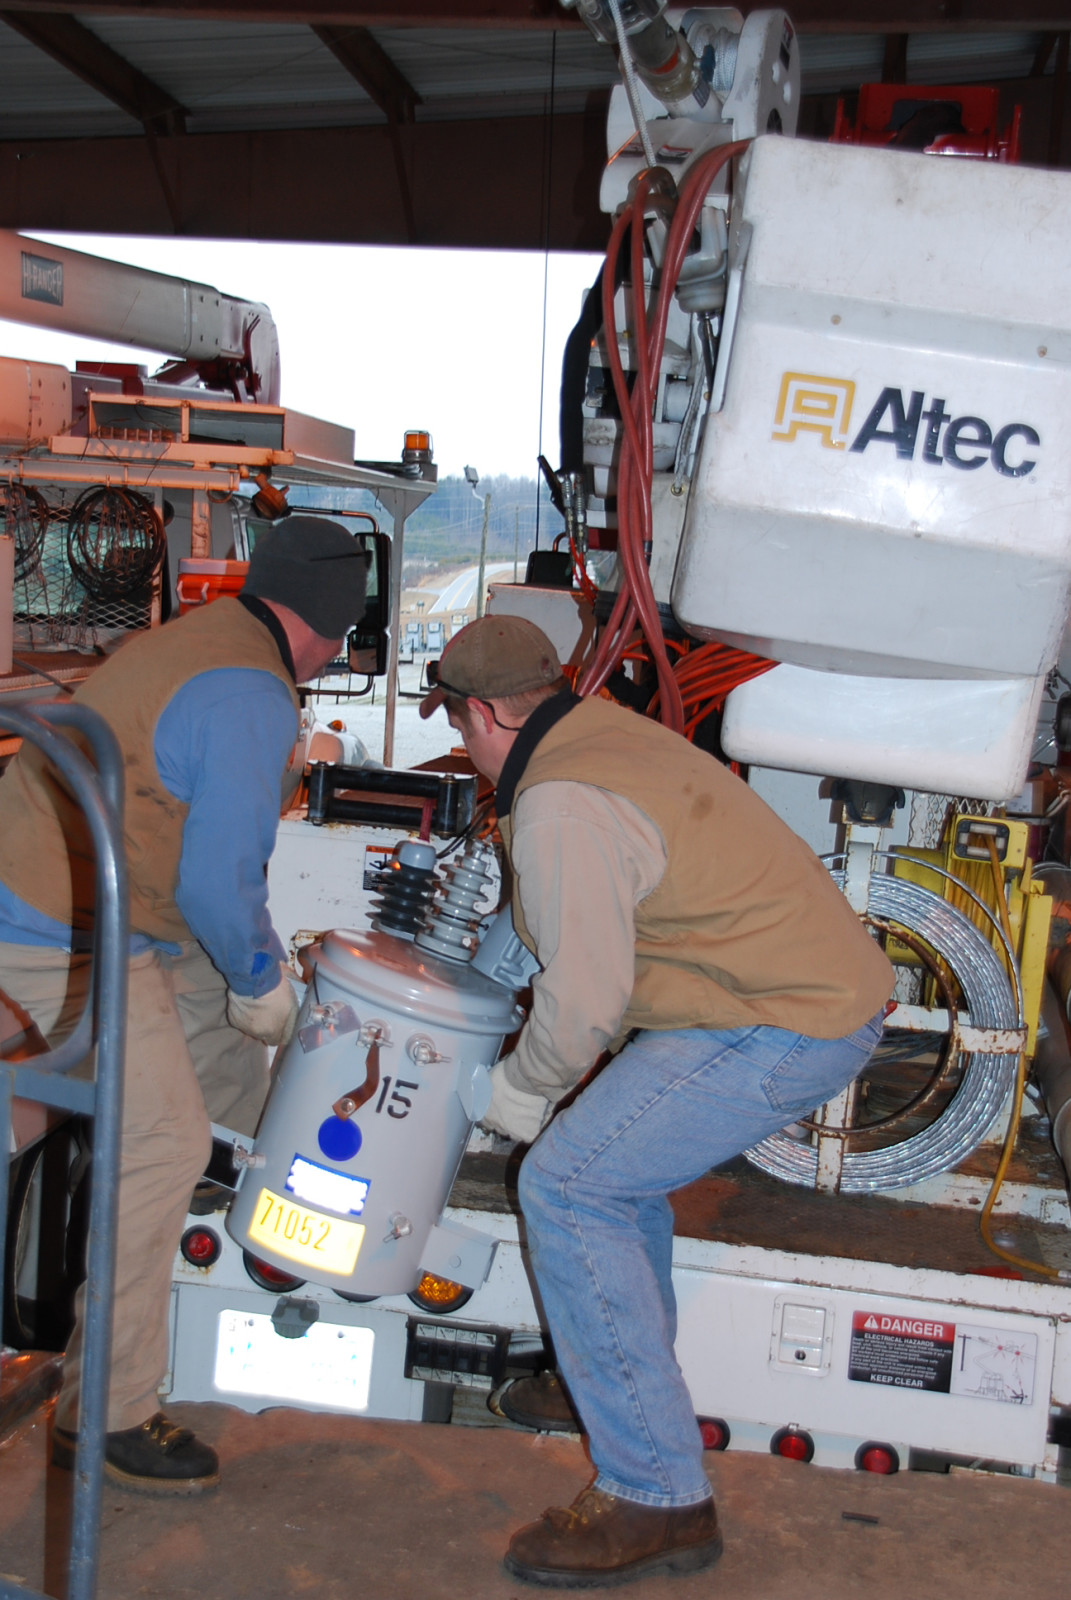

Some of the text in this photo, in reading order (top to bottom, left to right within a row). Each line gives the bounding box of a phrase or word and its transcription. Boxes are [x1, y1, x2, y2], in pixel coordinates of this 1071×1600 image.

[848, 386, 1040, 478] Altec
[375, 1075, 419, 1119] 15
[260, 1195, 331, 1252] 71052
[864, 1333, 935, 1348] ELECTRICAL HAZARDS
[881, 1317, 944, 1337] DANGER
[870, 1373, 923, 1387] KEEP CLEAR
